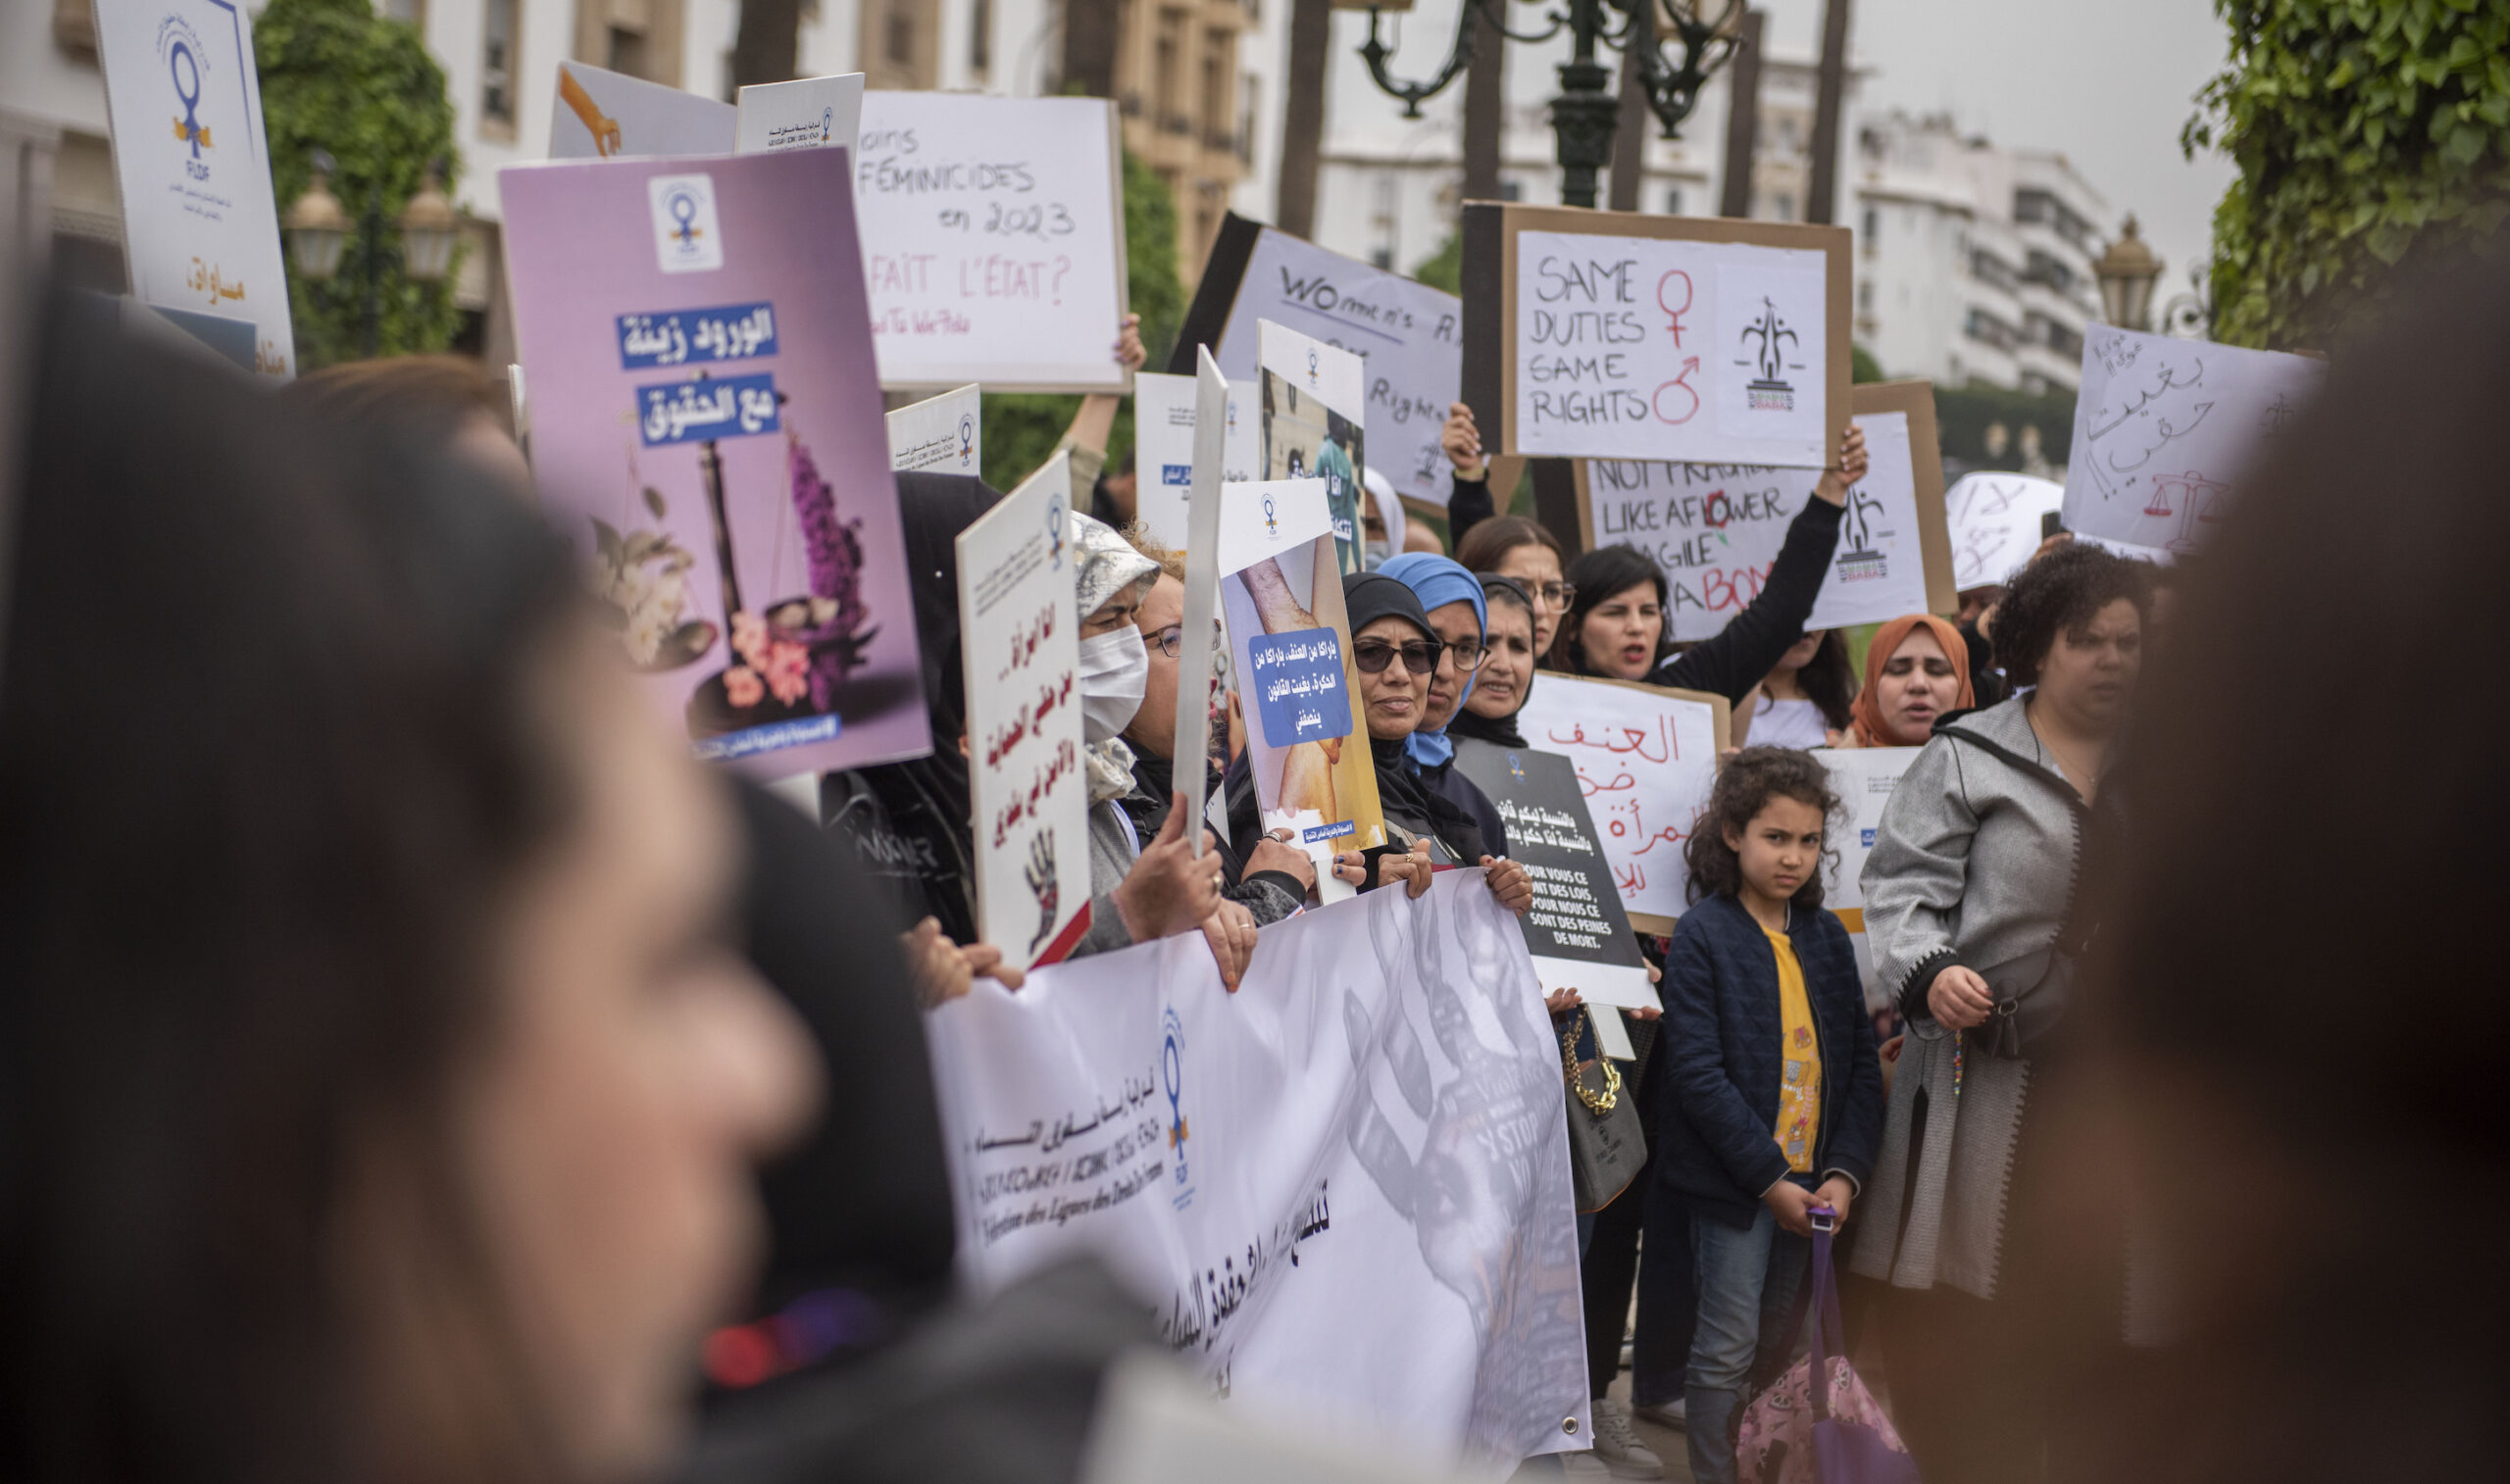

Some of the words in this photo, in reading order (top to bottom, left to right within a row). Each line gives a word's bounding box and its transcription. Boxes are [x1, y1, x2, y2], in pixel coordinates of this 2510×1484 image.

[860, 126, 920, 155] oins
[858, 155, 1036, 194] FÉMINICIDES
[938, 208, 971, 232] en
[983, 201, 1077, 243] 2023
[871, 253, 937, 294] FAIT
[1535, 255, 1638, 304] SAME
[623, 315, 688, 366] زينة
[694, 307, 773, 359] الورود
[1530, 309, 1646, 347] DUTIES
[1530, 353, 1629, 384] SAME
[643, 384, 736, 441] الحقوق
[738, 387, 776, 433] مع
[1369, 376, 1446, 425] Rights
[1529, 388, 1649, 425] RIGHTS
[2086, 357, 2204, 442] بغيت
[2108, 400, 2216, 487] حقي
[1604, 499, 1660, 534] LIKE
[1641, 531, 1718, 569] AGILE
[1674, 581, 1706, 611] A
[1703, 560, 1775, 612] BOM
[1255, 652, 1266, 670] من
[1265, 647, 1285, 668] باراكا
[1308, 645, 1318, 663] من
[1317, 639, 1337, 661] باراكا
[1267, 677, 1291, 703] القانون
[1290, 674, 1312, 699] بغيت
[1295, 708, 1323, 735] ينصفني
[1548, 713, 1680, 764] العنف
[1497, 799, 1517, 822] قانو
[1539, 806, 1578, 833] بالنسبة
[1556, 829, 1594, 858] بالنسبة
[1546, 866, 1575, 883] VOUS
[1574, 871, 1588, 885] CE
[1531, 896, 1559, 913] POUR
[1558, 900, 1586, 916] NOUS
[1586, 904, 1601, 917] CE
[1548, 883, 1569, 898] DES
[1569, 885, 1592, 902] LOIS
[1530, 912, 1557, 928] SONT
[1557, 915, 1578, 930] DES
[1577, 918, 1613, 935] PEINES
[1552, 930, 1570, 945] DE
[1568, 933, 1601, 950] MORT.
